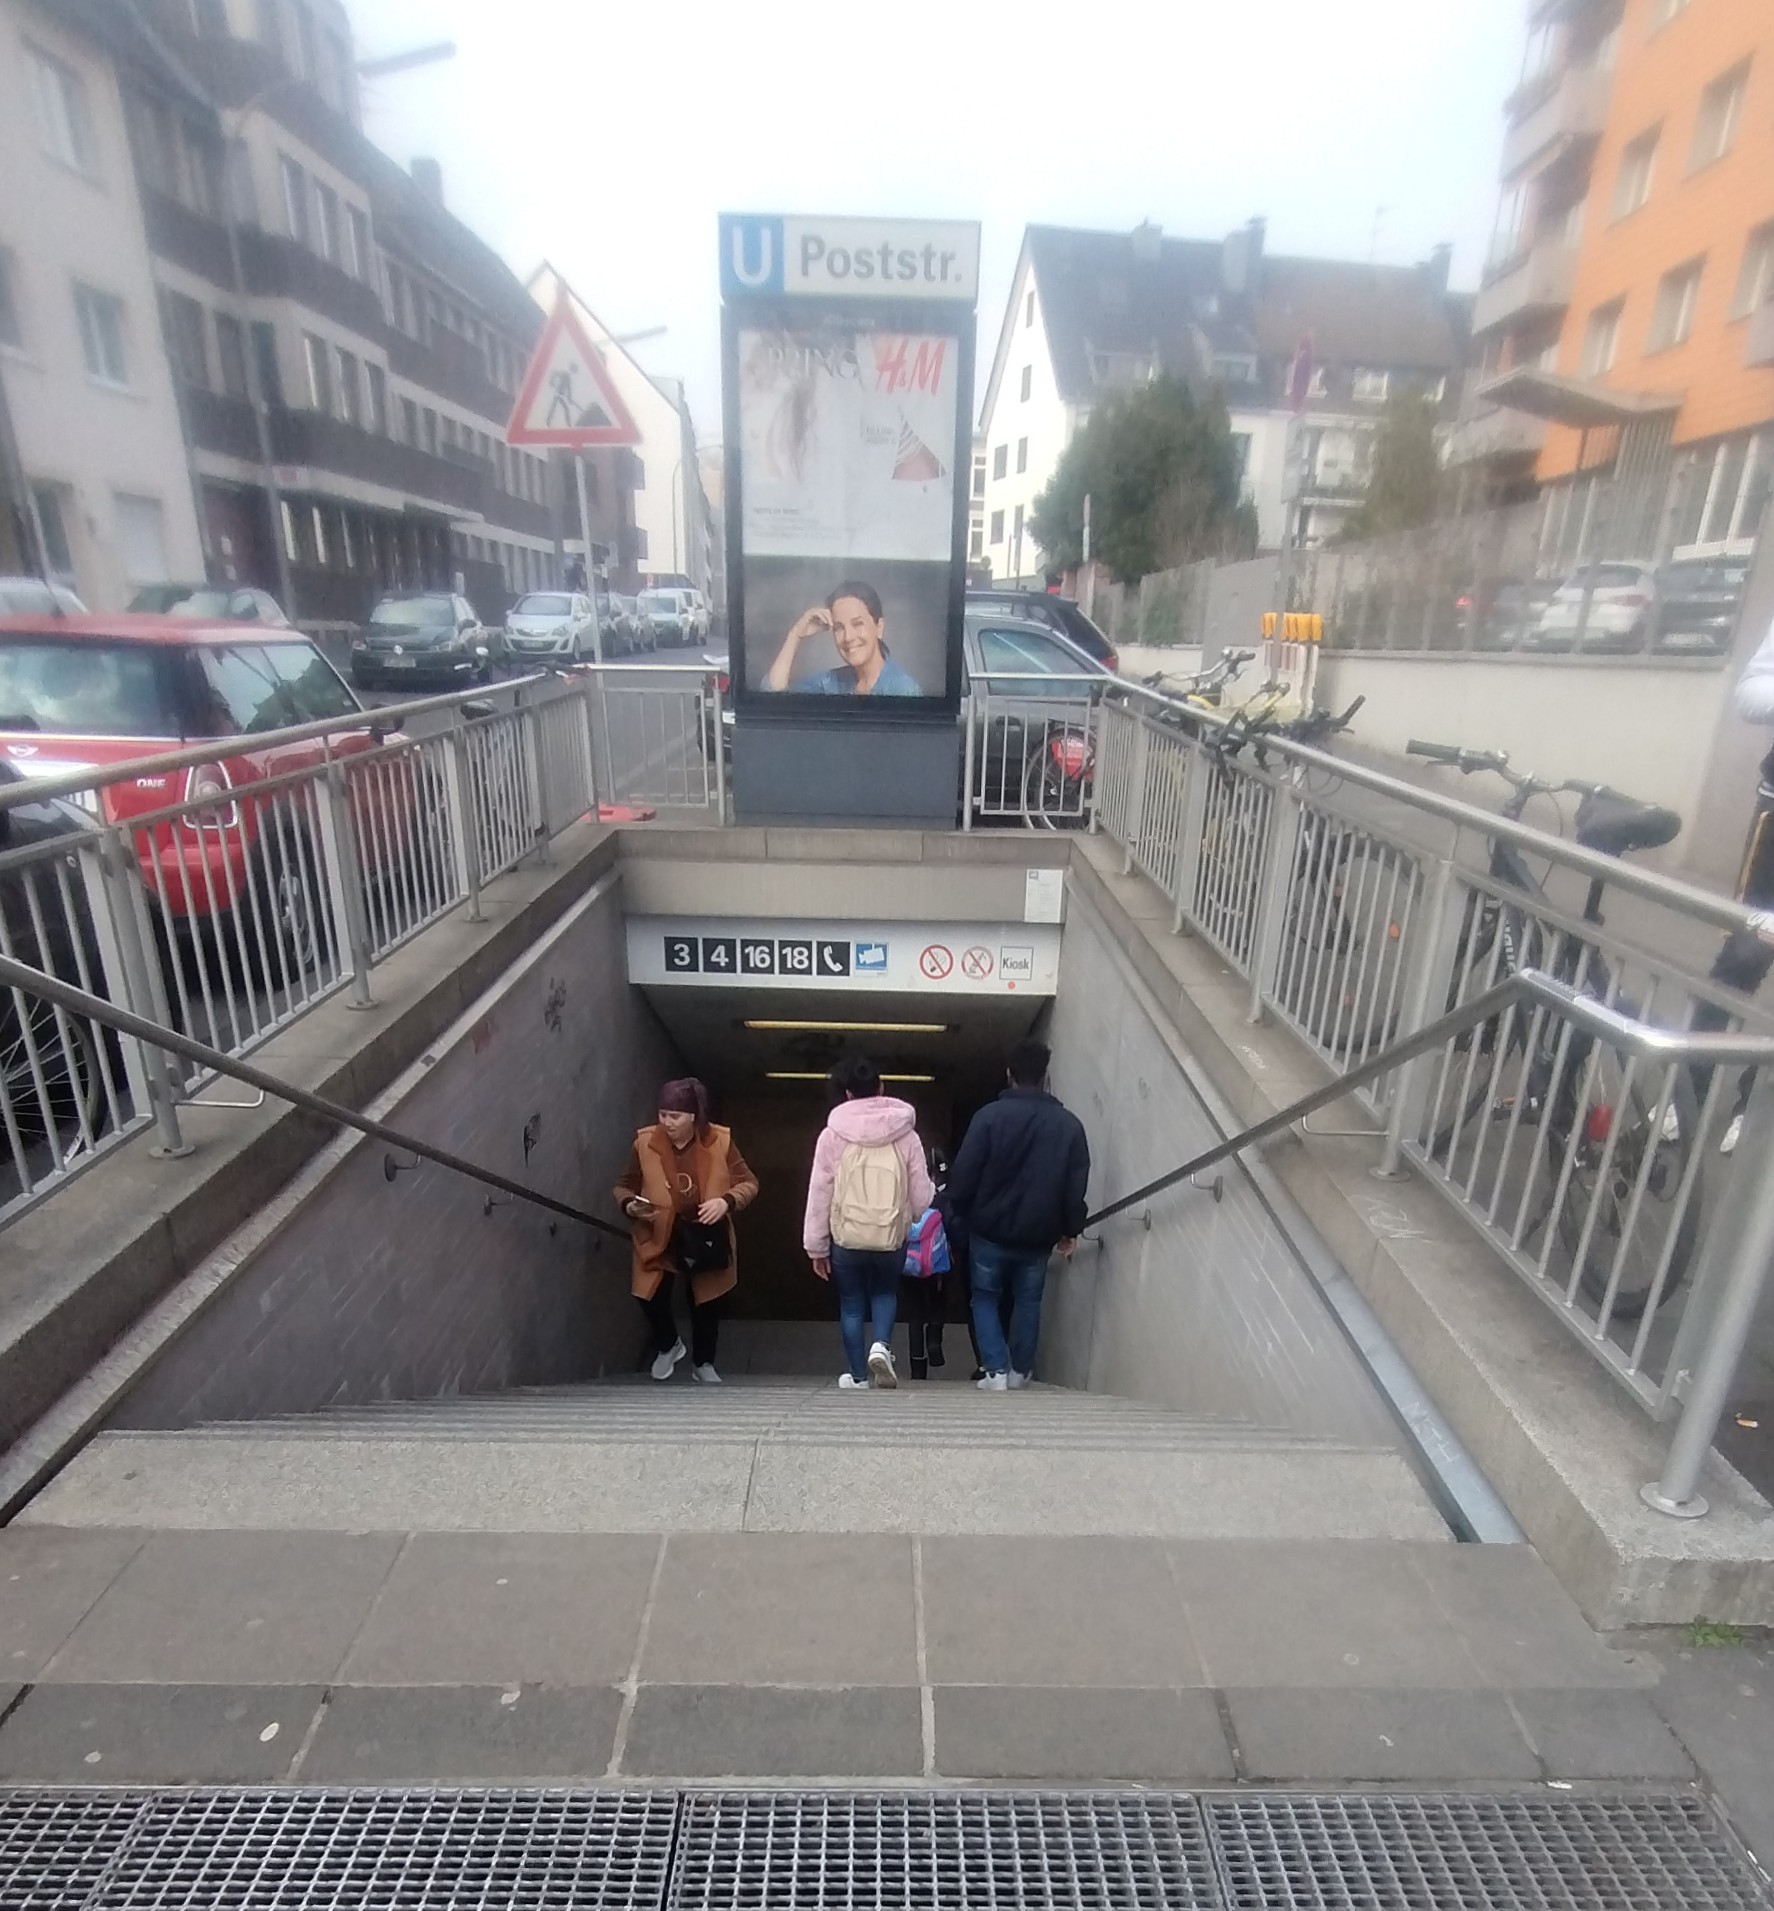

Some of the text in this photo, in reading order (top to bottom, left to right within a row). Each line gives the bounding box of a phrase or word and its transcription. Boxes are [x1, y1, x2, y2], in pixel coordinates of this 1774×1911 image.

[732, 224, 772, 285] U
[800, 233, 962, 283] Poststr.
[877, 338, 947, 395] H&M
[673, 943, 1030, 970] 3 4 16 18 Kiosk
